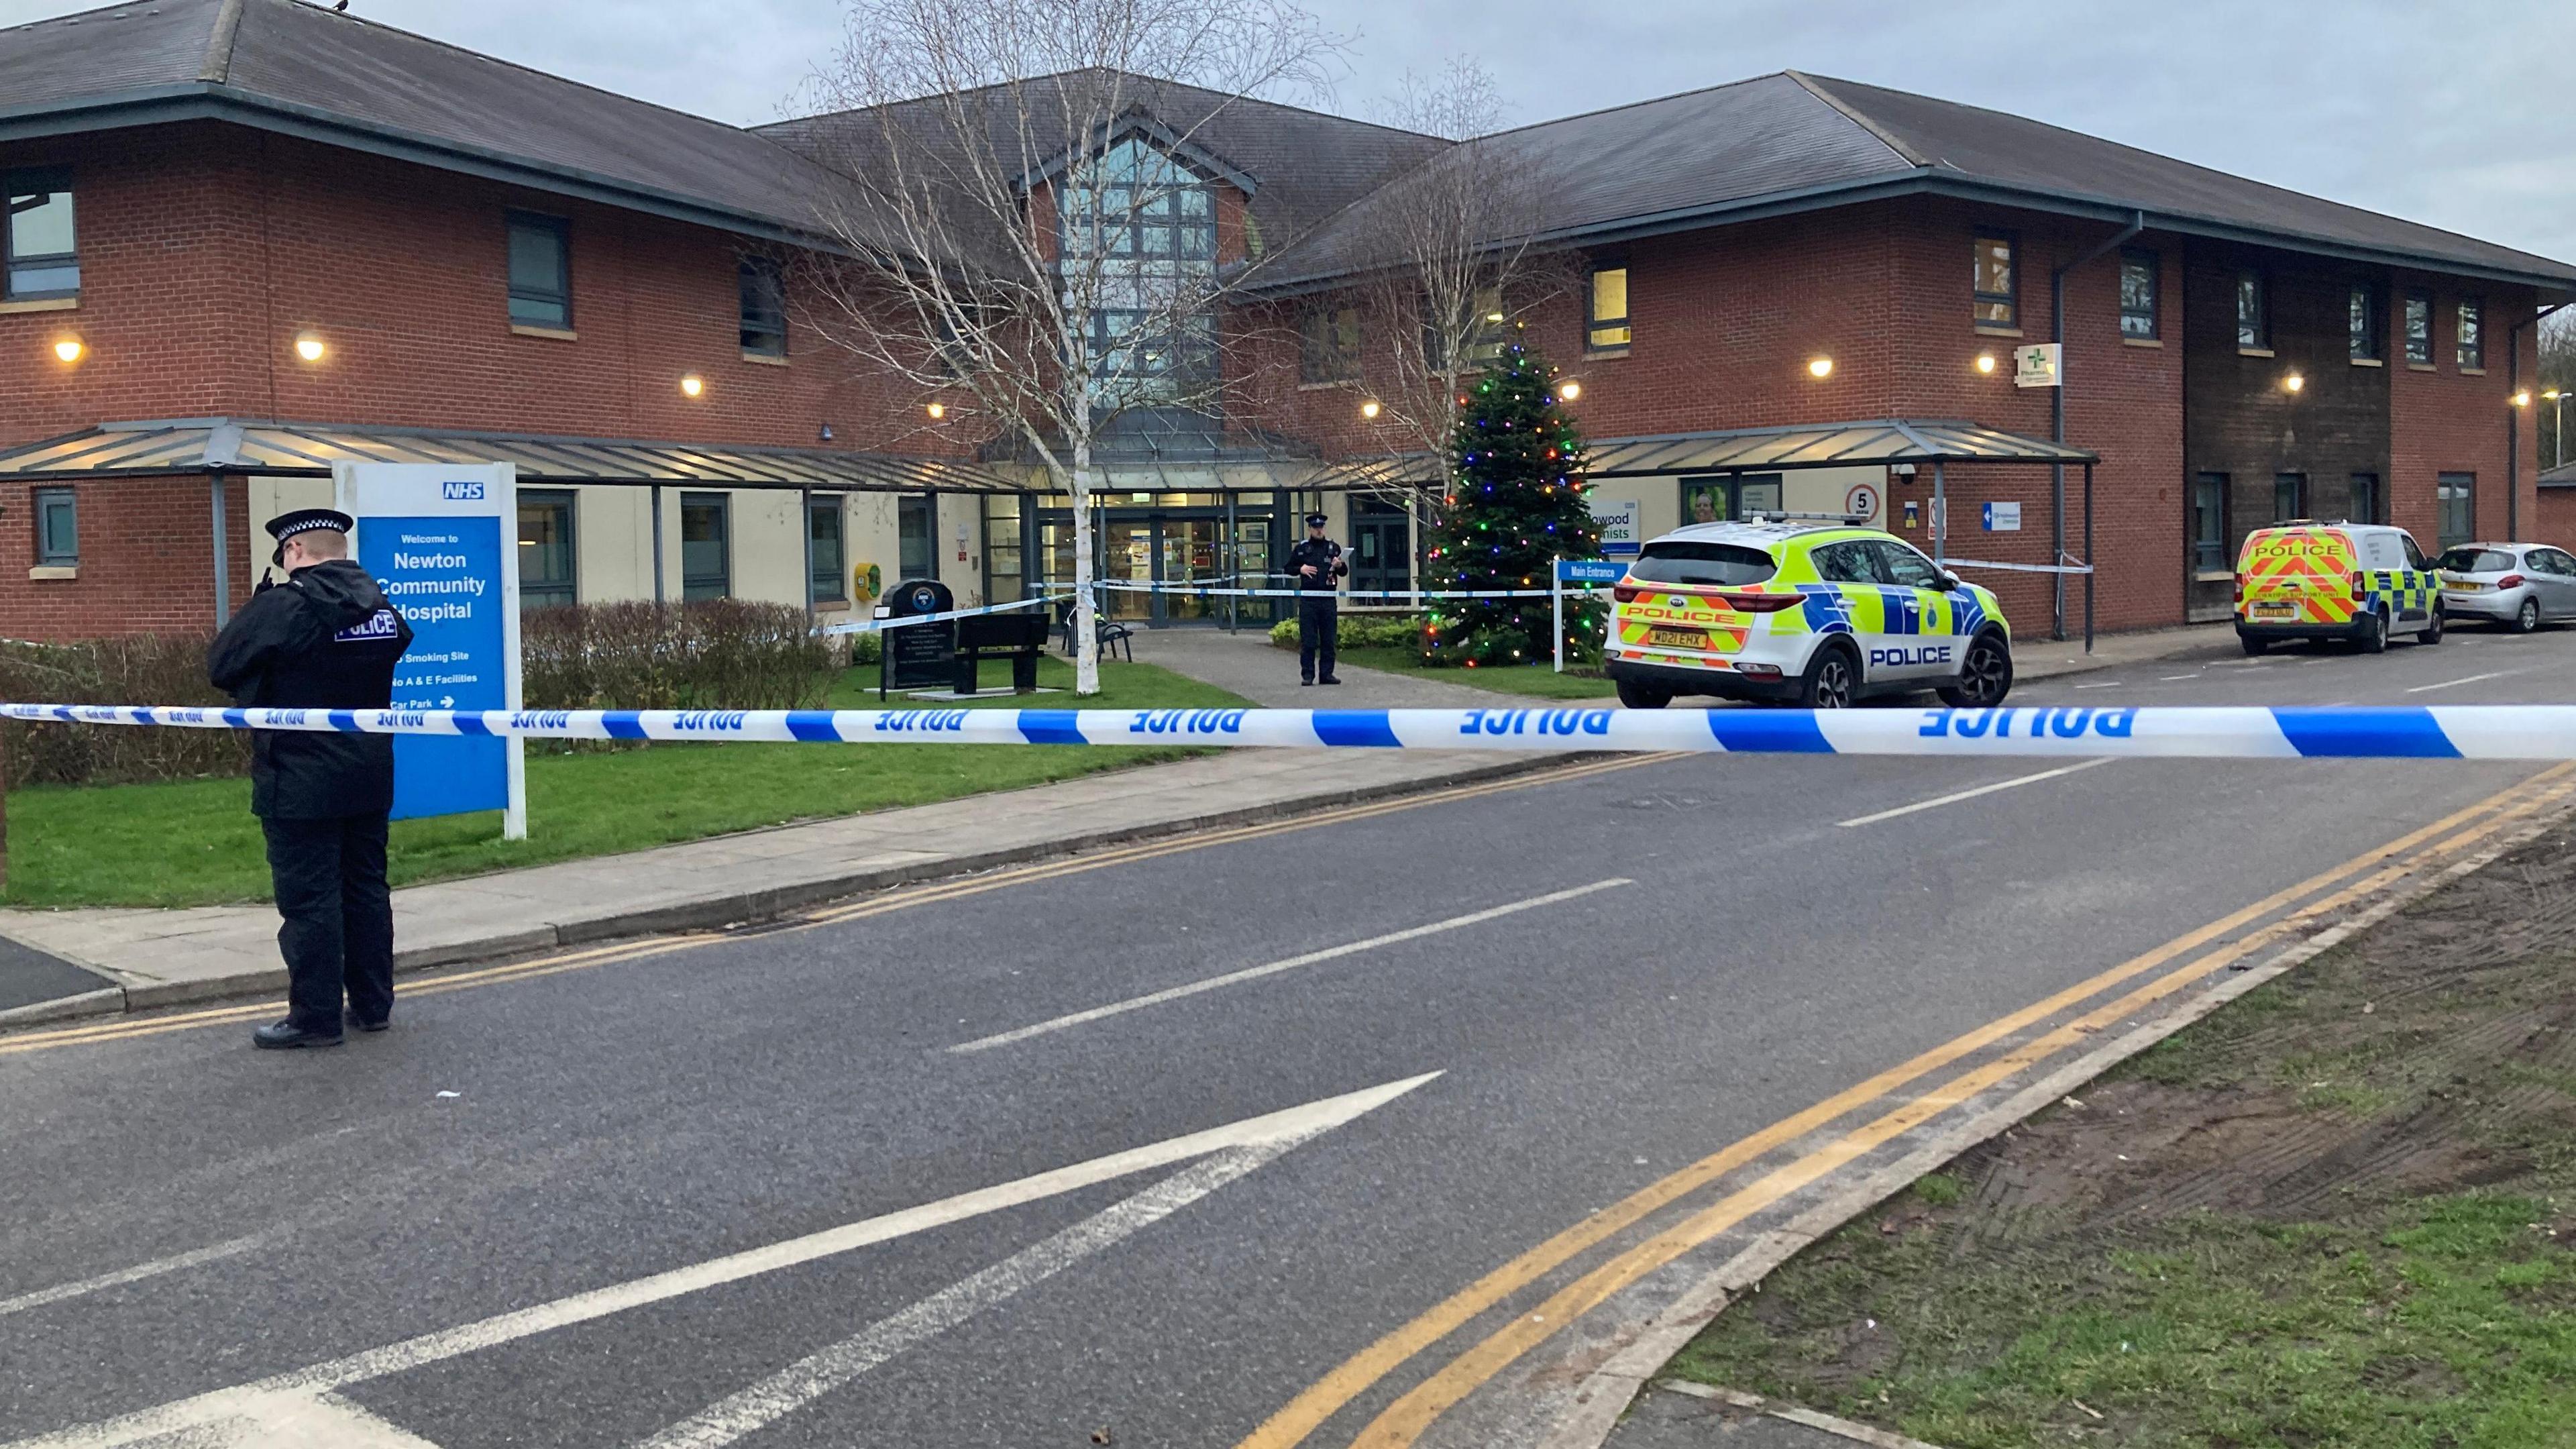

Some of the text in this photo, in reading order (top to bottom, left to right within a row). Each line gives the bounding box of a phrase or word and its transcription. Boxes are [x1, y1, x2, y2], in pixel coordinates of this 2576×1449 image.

[444, 483, 482, 498] NHS
[1858, 493, 1867, 508] 5
[1592, 513, 1629, 525] owood
[401, 535, 458, 544] Welcome to
[2255, 545, 2342, 557] POLICE
[394, 553, 466, 569] Newton
[1571, 566, 1615, 578] Main Entrance
[376, 576, 486, 596] Community
[392, 602, 472, 623] Hospital
[1627, 607, 1736, 624] POLICE
[1679, 633, 1700, 646] EHX
[405, 653, 448, 663] Smoking
[451, 651, 469, 661] Site
[1870, 646, 1951, 667] POLICE
[406, 677, 413, 686] A
[416, 676, 423, 686] &
[426, 676, 433, 684] E
[435, 674, 478, 684] Facilities
[390, 698, 433, 710] Car Park
[1918, 707, 2139, 741] POLICE
